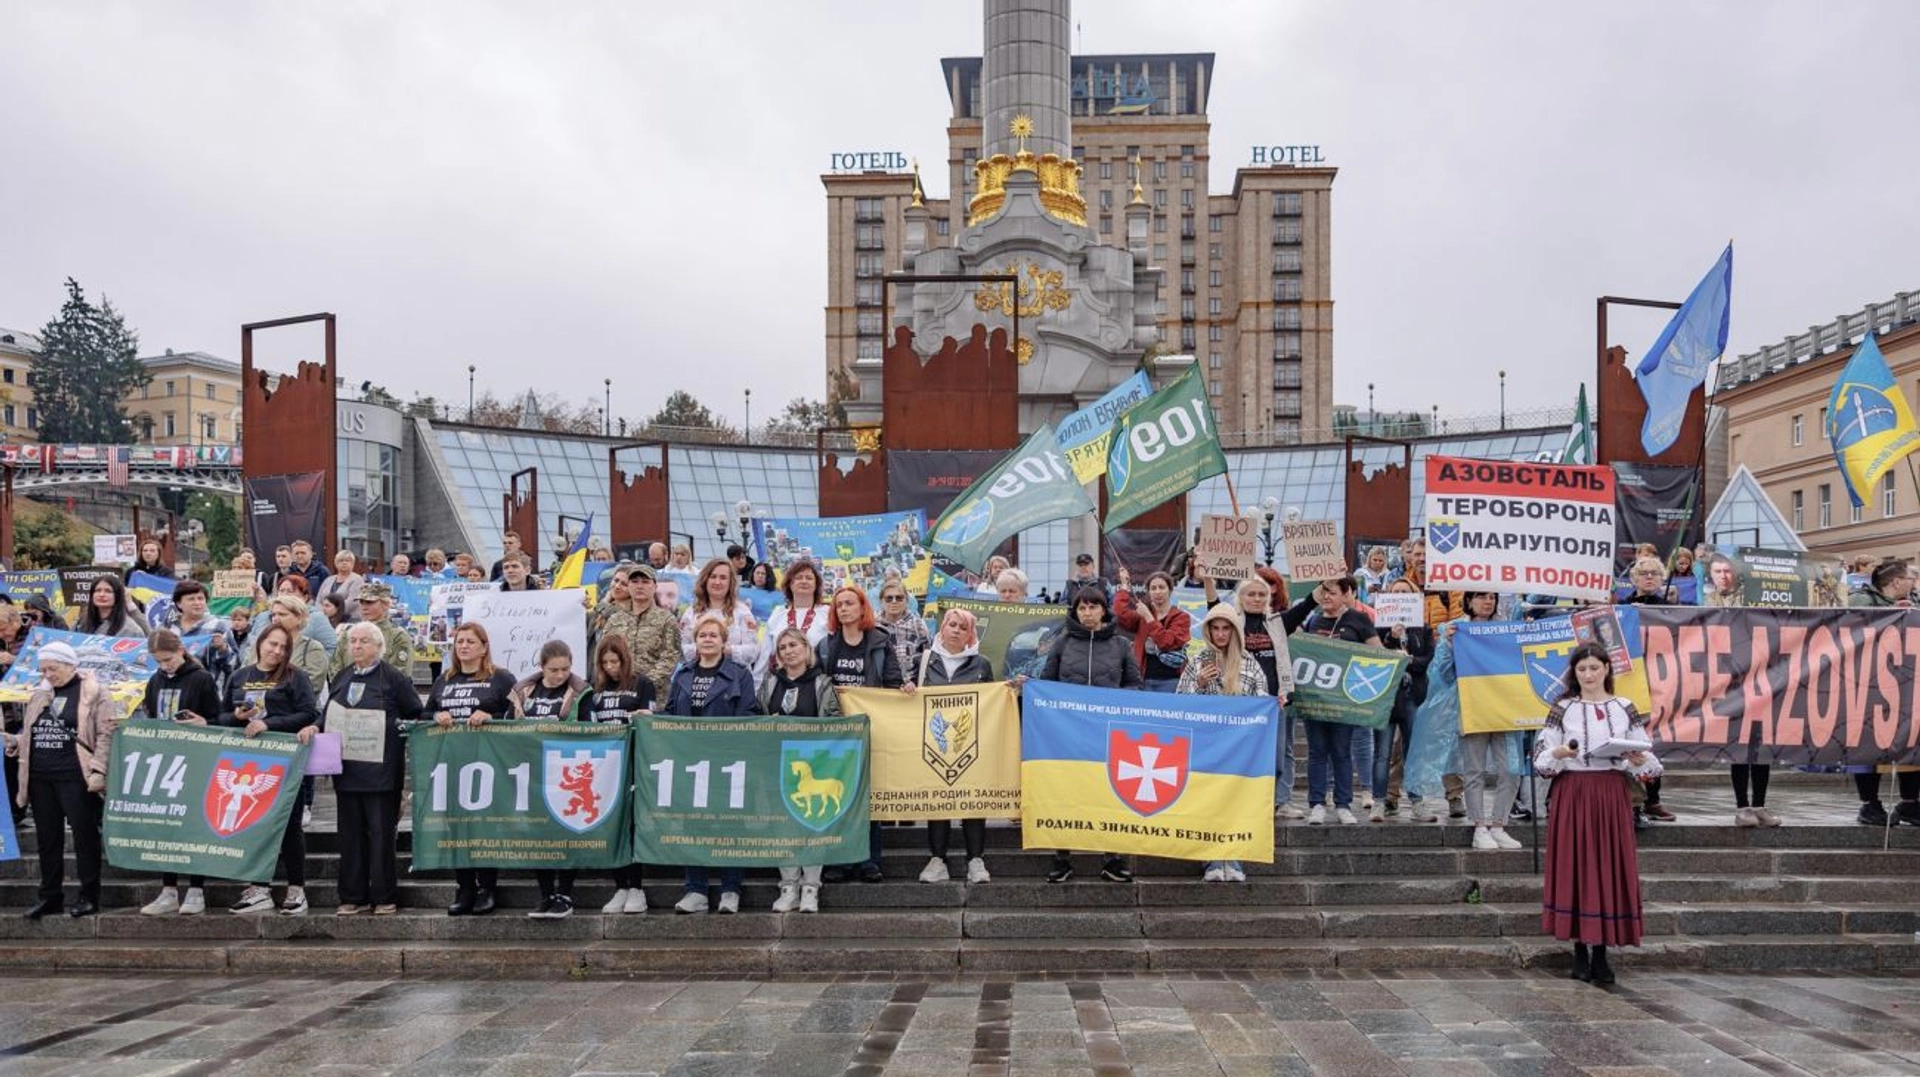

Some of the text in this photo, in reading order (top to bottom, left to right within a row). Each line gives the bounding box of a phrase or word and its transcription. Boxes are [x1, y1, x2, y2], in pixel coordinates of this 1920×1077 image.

[830, 152, 907, 169] ГОТЕЛЬ
[1252, 146, 1325, 163] HOTEL
[1438, 463, 1605, 490] АЗОВСТАЛЬ
[1437, 498, 1612, 525] ТЕРОБОРОНА
[1211, 517, 1249, 536] ТРО
[1294, 543, 1334, 557] НАШИХ
[1462, 532, 1611, 558] МАРІУПОЛЯ
[1295, 561, 1337, 578] ГЕРОЇВ
[1428, 563, 1611, 590] ДОСІ В ПОЛОНІ
[1761, 591, 1792, 602] ДОСІ
[988, 605, 1025, 614] ГЕРОЇВ
[1509, 622, 1540, 633] БРИГАДА
[837, 659, 855, 669] 120
[1640, 626, 1731, 743] REE
[931, 696, 973, 709] ЖІНКИ
[1058, 700, 1086, 711] ОКРЕМА
[1088, 704, 1121, 715] БРИГАДА
[777, 723, 820, 732] ОБОРОНИ
[122, 751, 188, 798] 114
[430, 761, 530, 811] 101
[650, 759, 746, 809] 111
[932, 790, 971, 801] РОДИН
[168, 803, 188, 816] ТРО
[960, 802, 1010, 810] ОБОРОНИ
[1036, 817, 1094, 831] РОДИНА
[1099, 821, 1170, 837] ЗНИКЛИХ
[711, 849, 759, 858] ЛУГАНСЬКА
